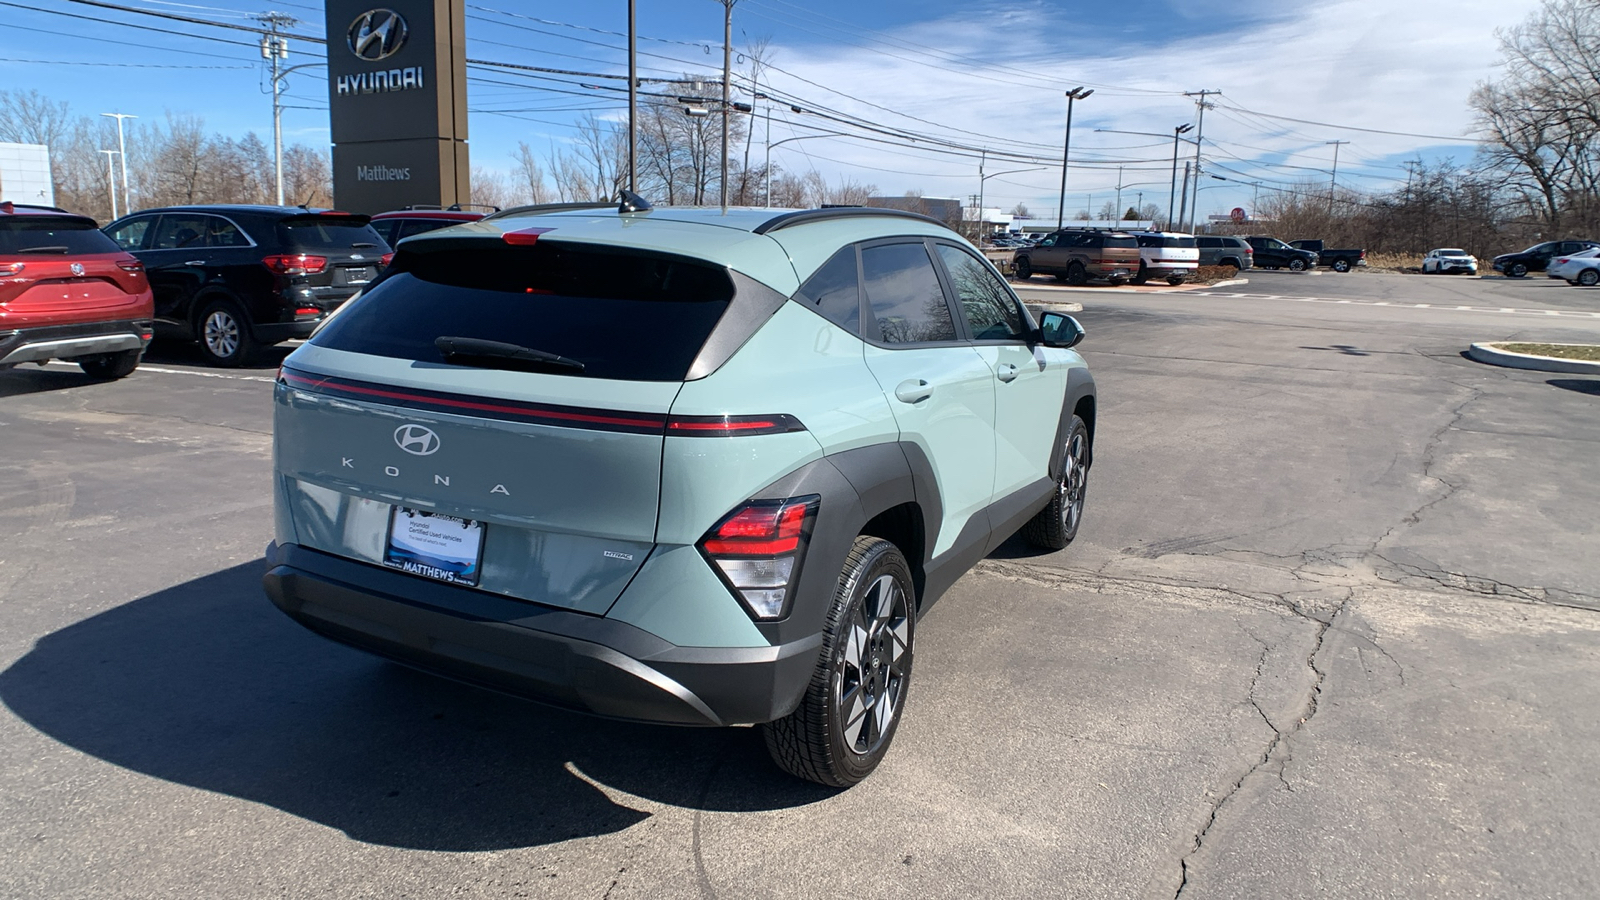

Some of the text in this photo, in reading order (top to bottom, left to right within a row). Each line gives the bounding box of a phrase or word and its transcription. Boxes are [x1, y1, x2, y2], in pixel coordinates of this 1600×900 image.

[337, 66, 424, 96] HYUNDAI
[357, 165, 410, 181] Matthews
[342, 457, 510, 496] KONA
[409, 520, 430, 529] Hyundai
[409, 527, 429, 536] Certified
[441, 534, 462, 543] Vehicles
[403, 561, 454, 581] MATTHEWS
